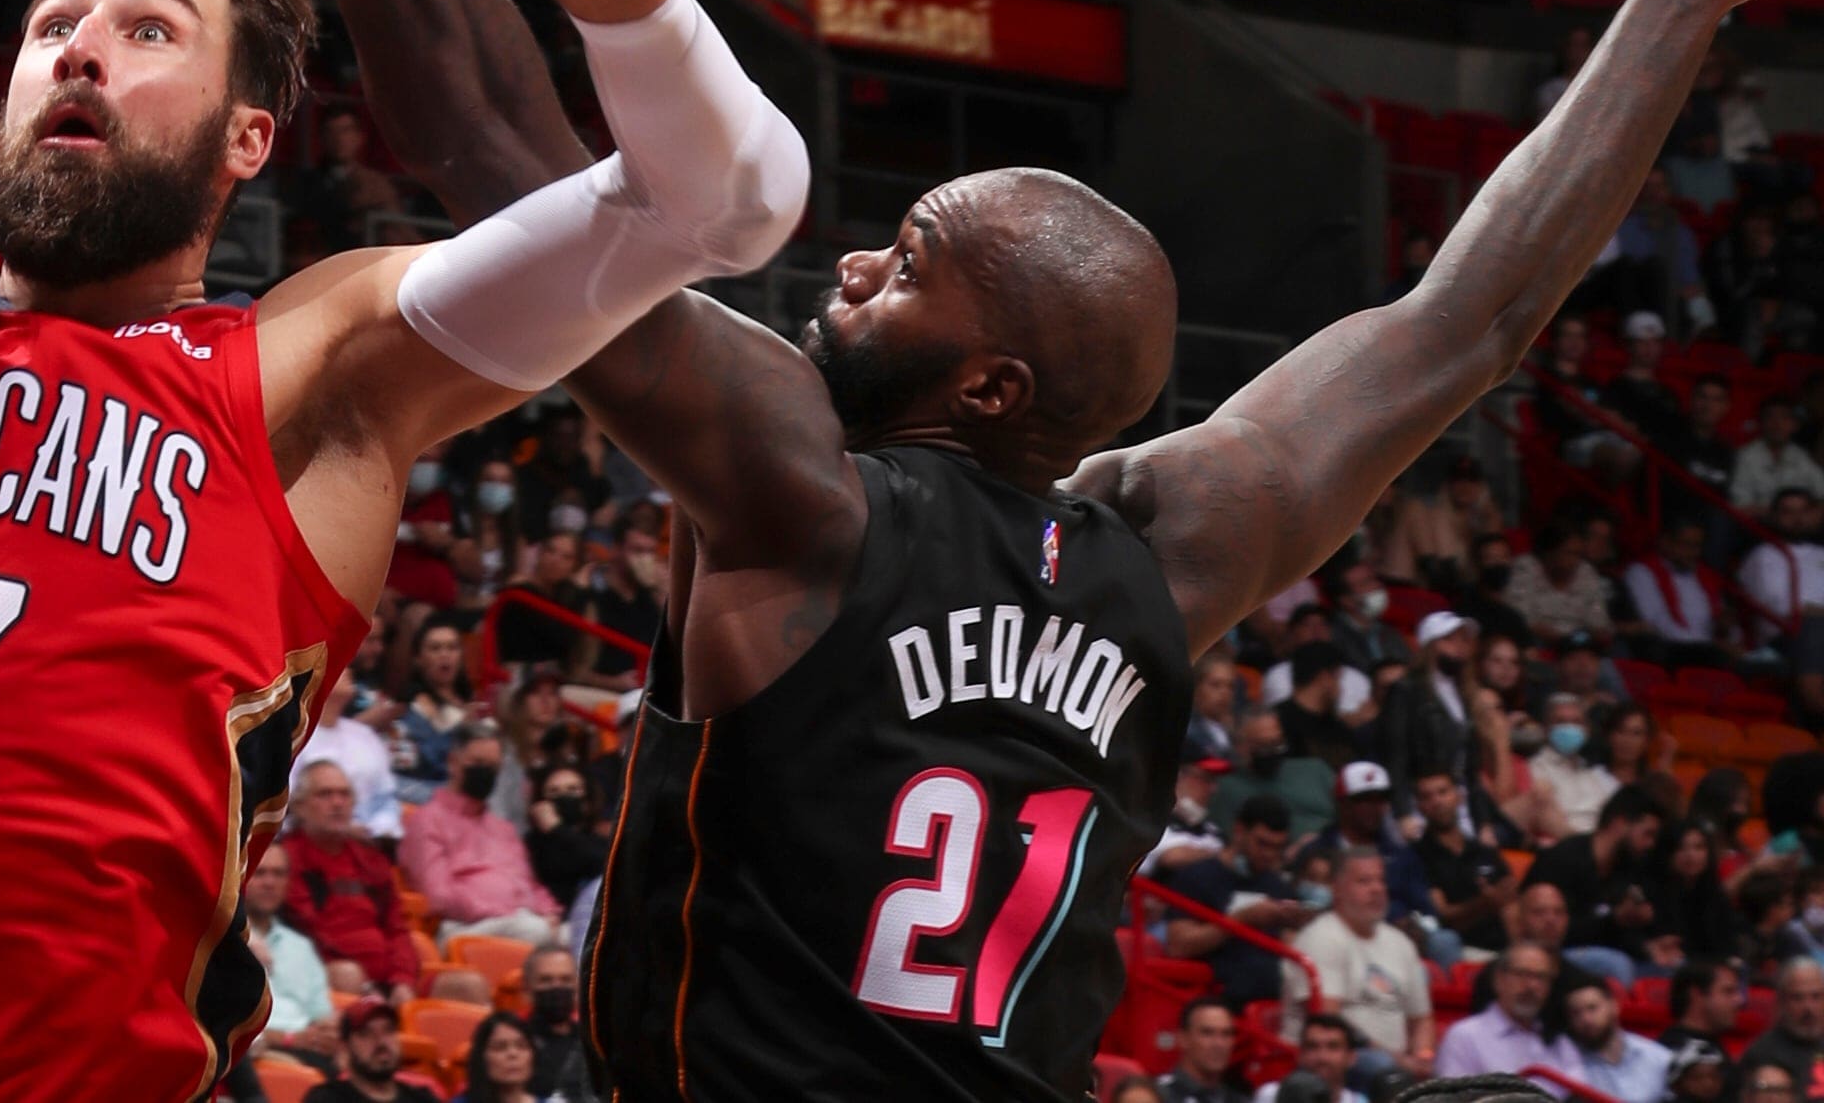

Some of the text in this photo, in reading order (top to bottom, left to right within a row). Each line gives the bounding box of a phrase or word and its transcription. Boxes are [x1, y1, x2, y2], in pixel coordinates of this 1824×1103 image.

[114, 321, 212, 359] ibotta
[889, 604, 1146, 760] DEDMON
[853, 766, 1099, 1049] 21
